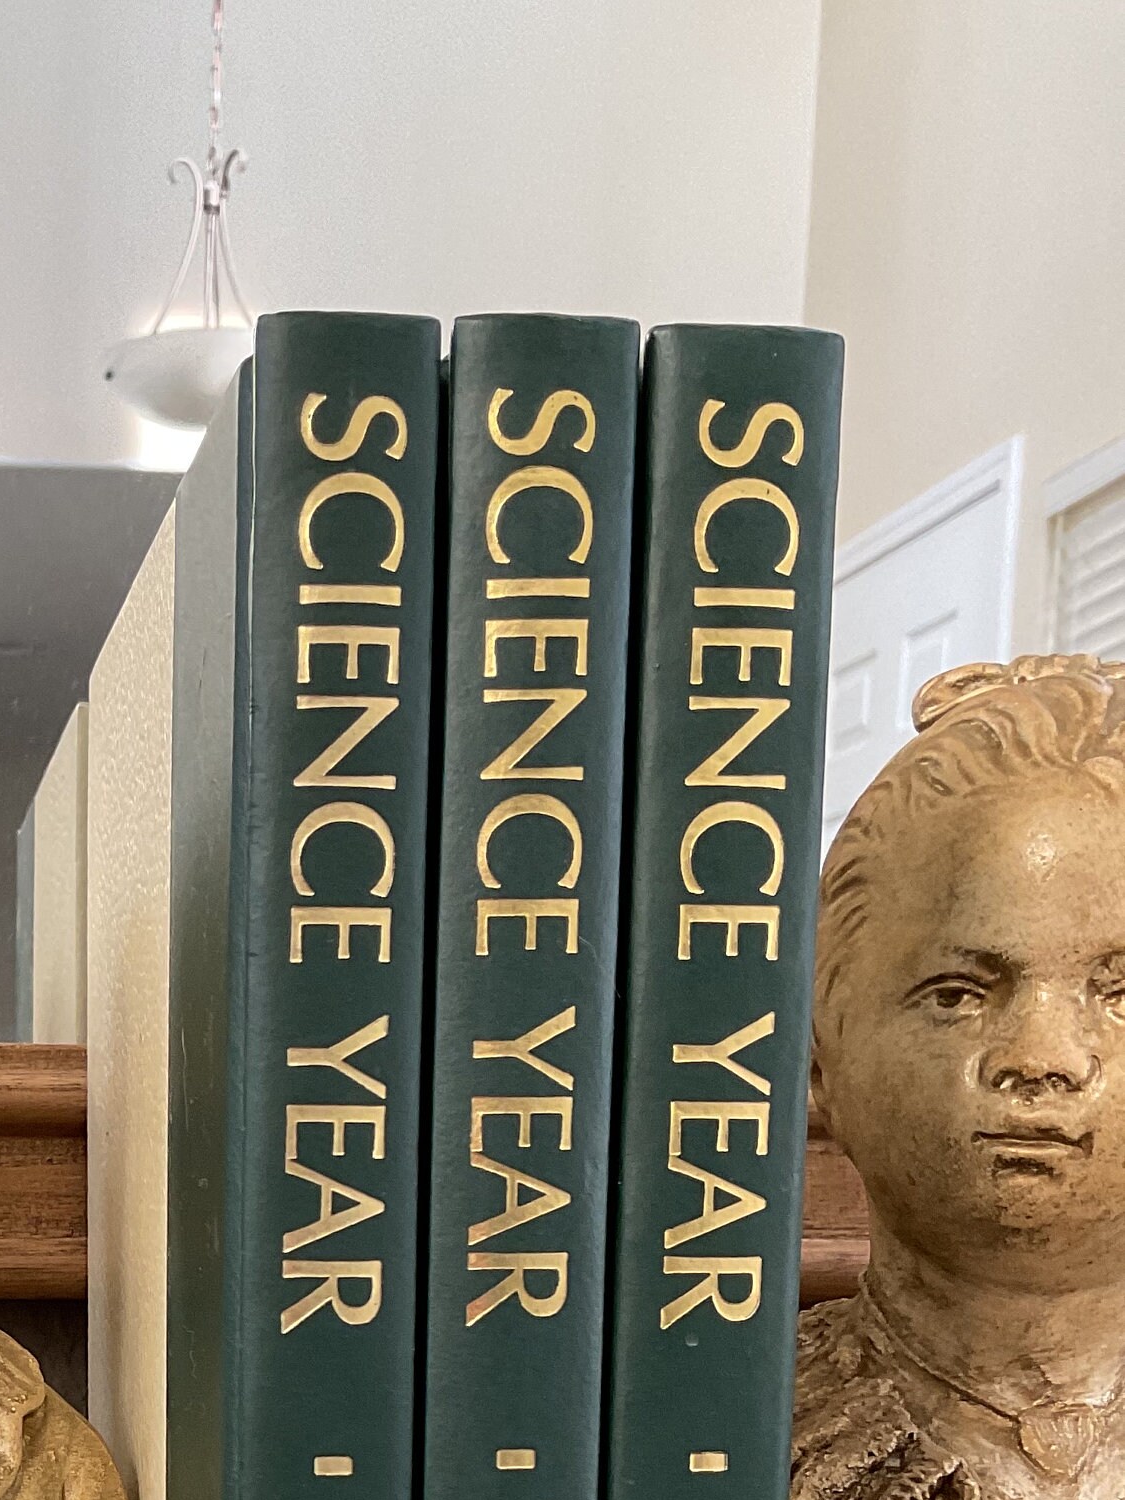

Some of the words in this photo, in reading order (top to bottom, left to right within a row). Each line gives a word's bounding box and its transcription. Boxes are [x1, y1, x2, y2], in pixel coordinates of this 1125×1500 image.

[289, 392, 408, 963] SCIENCE
[475, 387, 596, 956] SCIENCE
[677, 398, 805, 961] SCIENCE
[280, 1014, 390, 1335] YEAR
[465, 1005, 576, 1328] YEAR
[659, 1010, 775, 1330] YEAR
